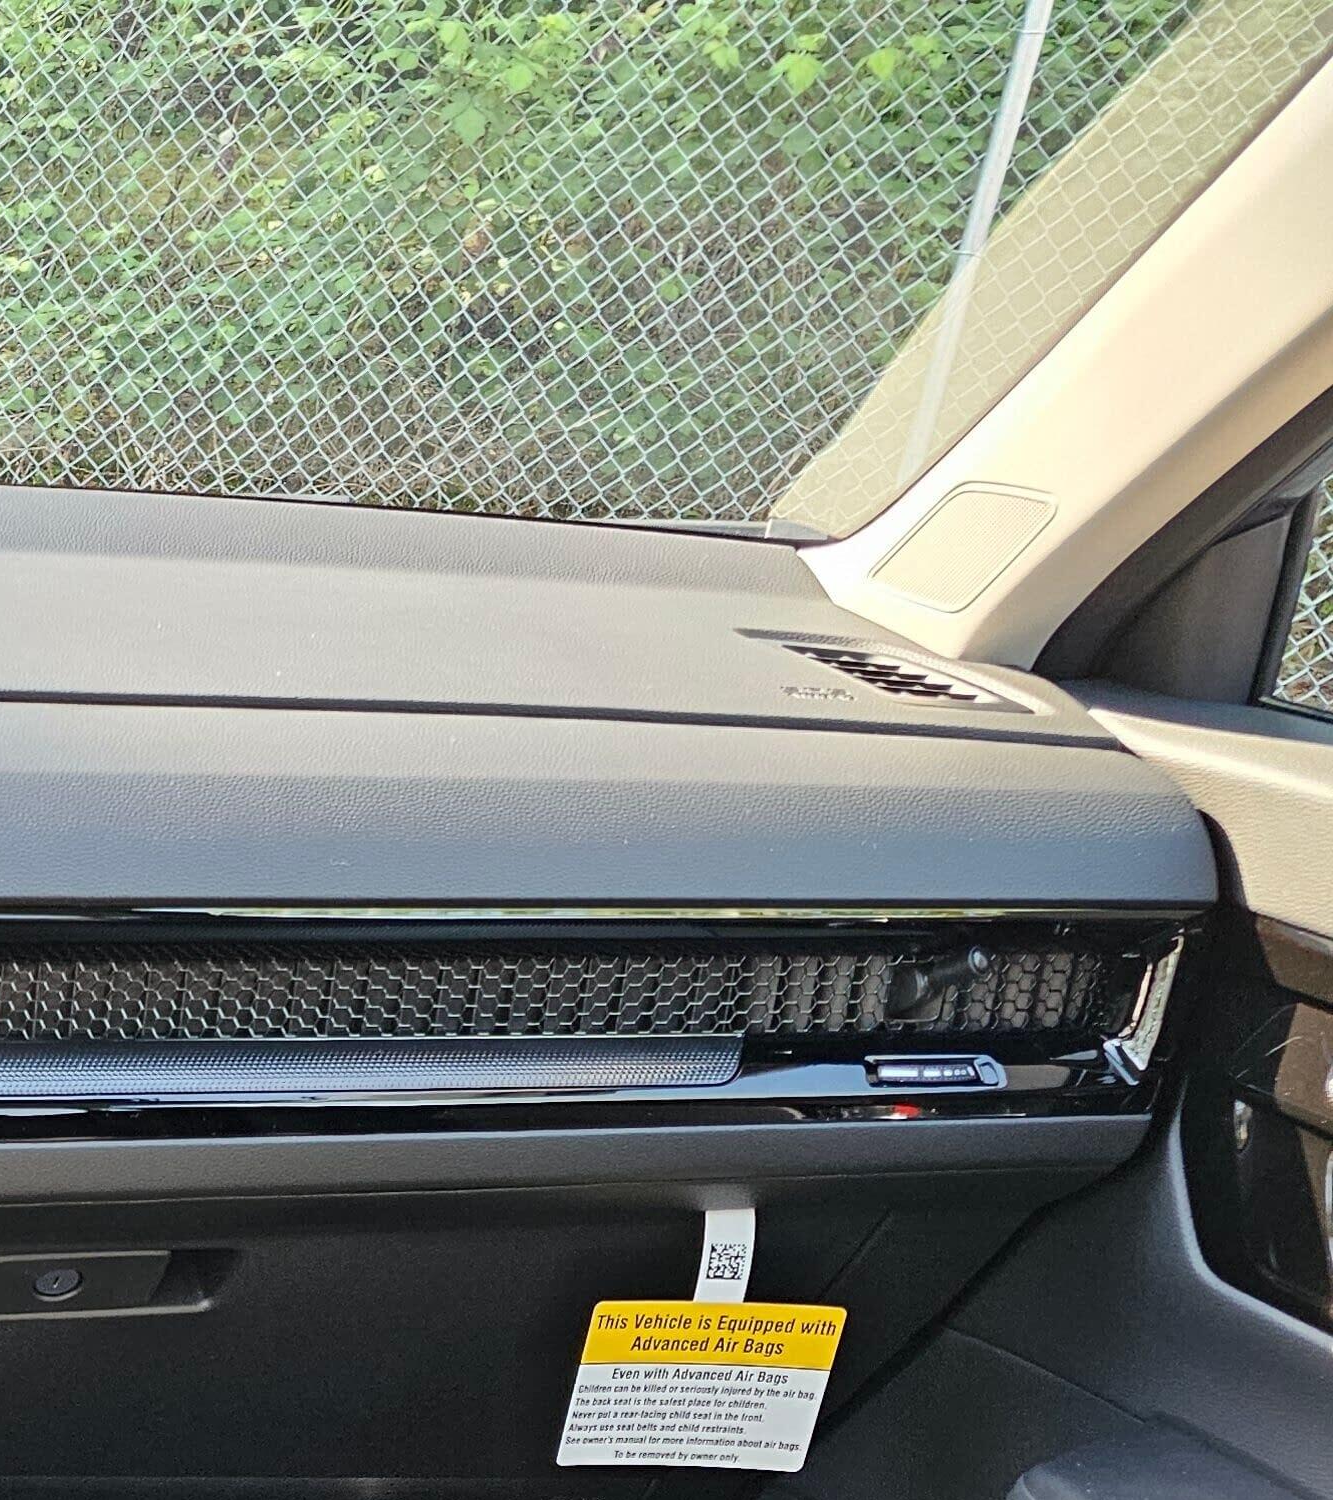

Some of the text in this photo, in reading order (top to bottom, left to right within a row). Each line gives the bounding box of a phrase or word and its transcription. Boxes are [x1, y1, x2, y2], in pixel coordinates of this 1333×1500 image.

[597, 1313, 837, 1336] This Vehicle is Equipped with
[630, 1335, 785, 1358] Advanced Air Bags
[611, 1368, 789, 1386] Even with Advanced Air Bags
[578, 1384, 612, 1394] Children
[613, 1385, 628, 1393] can
[631, 1384, 641, 1393] be
[643, 1384, 667, 1393] killed
[669, 1385, 678, 1393] or
[679, 1385, 719, 1397] seriously
[720, 1386, 752, 1397] injured
[754, 1387, 765, 1398] by
[766, 1388, 781, 1397] the
[782, 1390, 796, 1399] air
[575, 1397, 767, 1410] The back seat is the safest place for children.
[572, 1410, 596, 1419] Never
[597, 1411, 611, 1420] put
[620, 1410, 667, 1421] rear-facing
[669, 1411, 691, 1419] child
[692, 1412, 712, 1420] seat
[713, 1412, 722, 1420] in
[724, 1412, 739, 1421] the
[741, 1413, 765, 1423] front.
[568, 1423, 597, 1433] Always
[616, 1423, 635, 1432] seat
[637, 1423, 658, 1432] belts
[659, 1423, 676, 1432] and
[678, 1423, 699, 1433] child
[701, 1425, 747, 1435] restraints.
[565, 1436, 803, 1452] See owner's manual for more information about air bags.
[614, 1450, 741, 1464] To be removed by owner only.
